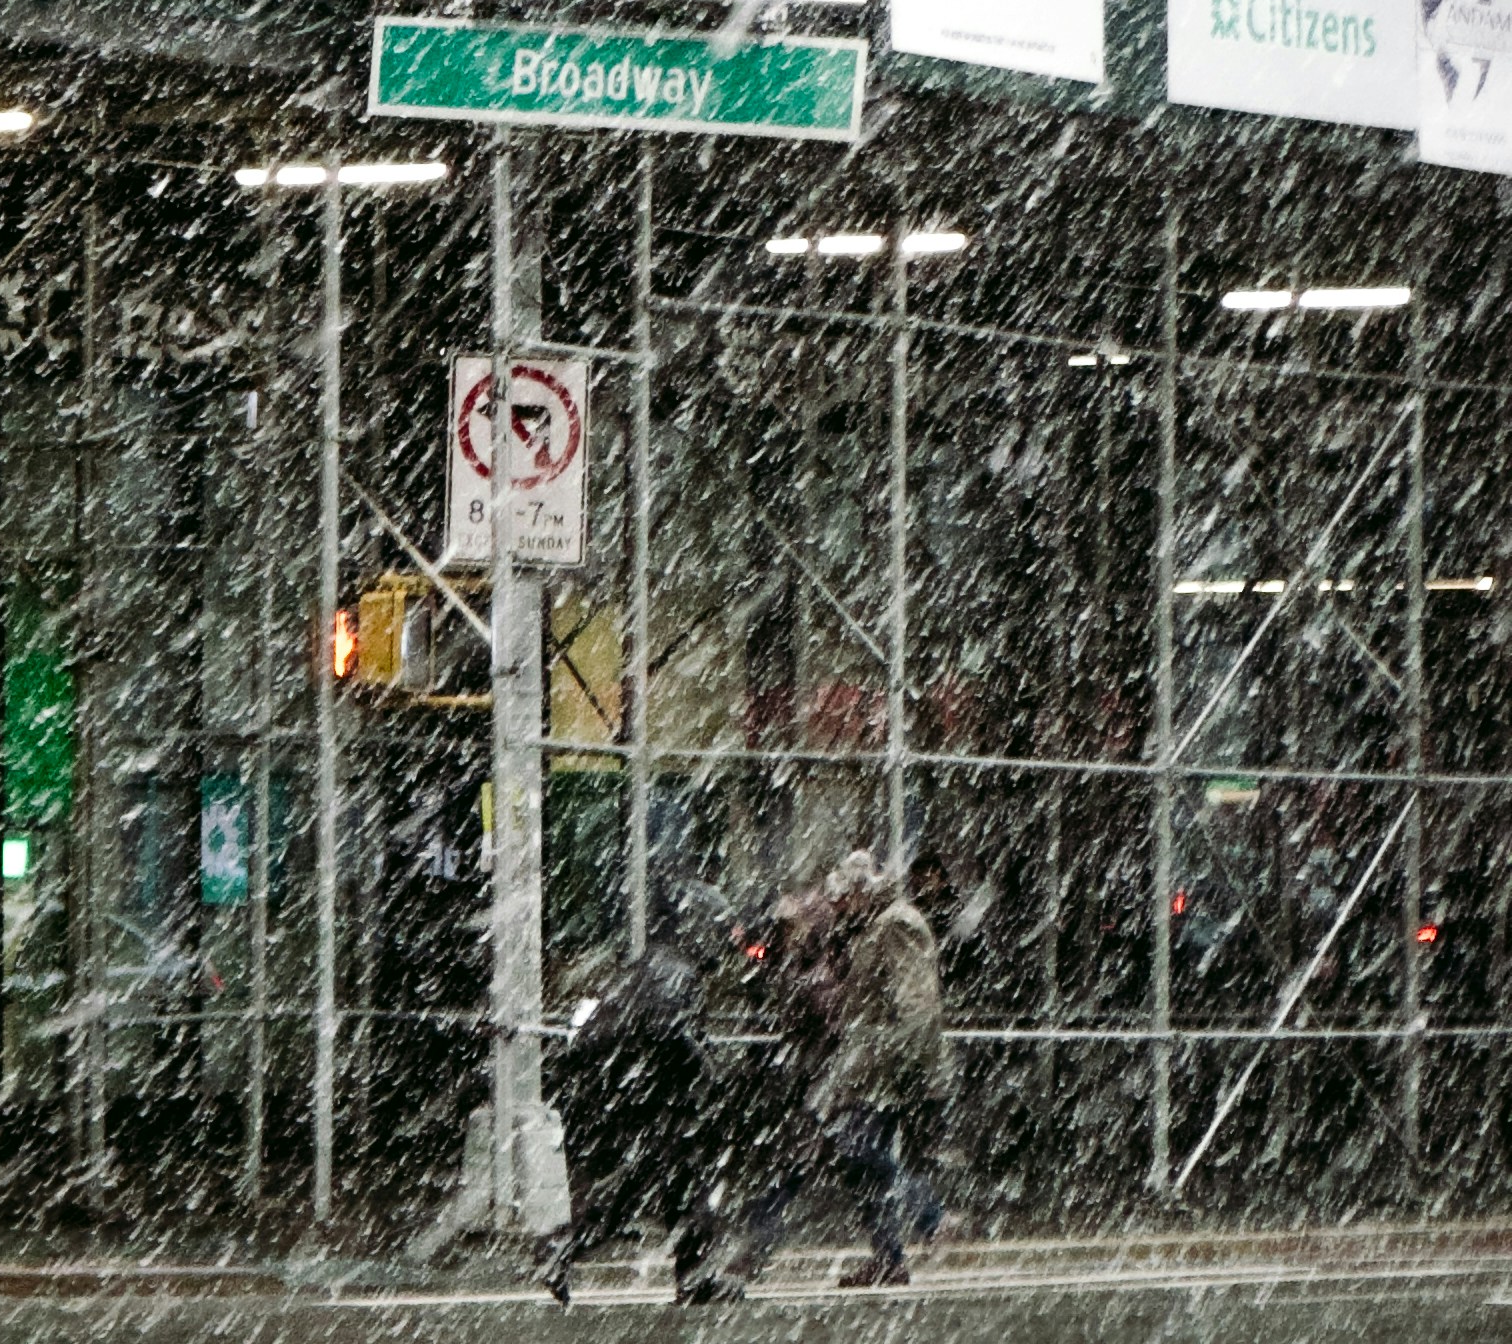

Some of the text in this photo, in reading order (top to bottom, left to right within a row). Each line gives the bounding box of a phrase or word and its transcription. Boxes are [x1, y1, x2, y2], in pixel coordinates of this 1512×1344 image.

[511, 47, 714, 116] Broadway
[469, 499, 484, 524] 8
[517, 535, 570, 550] SUNDAY
